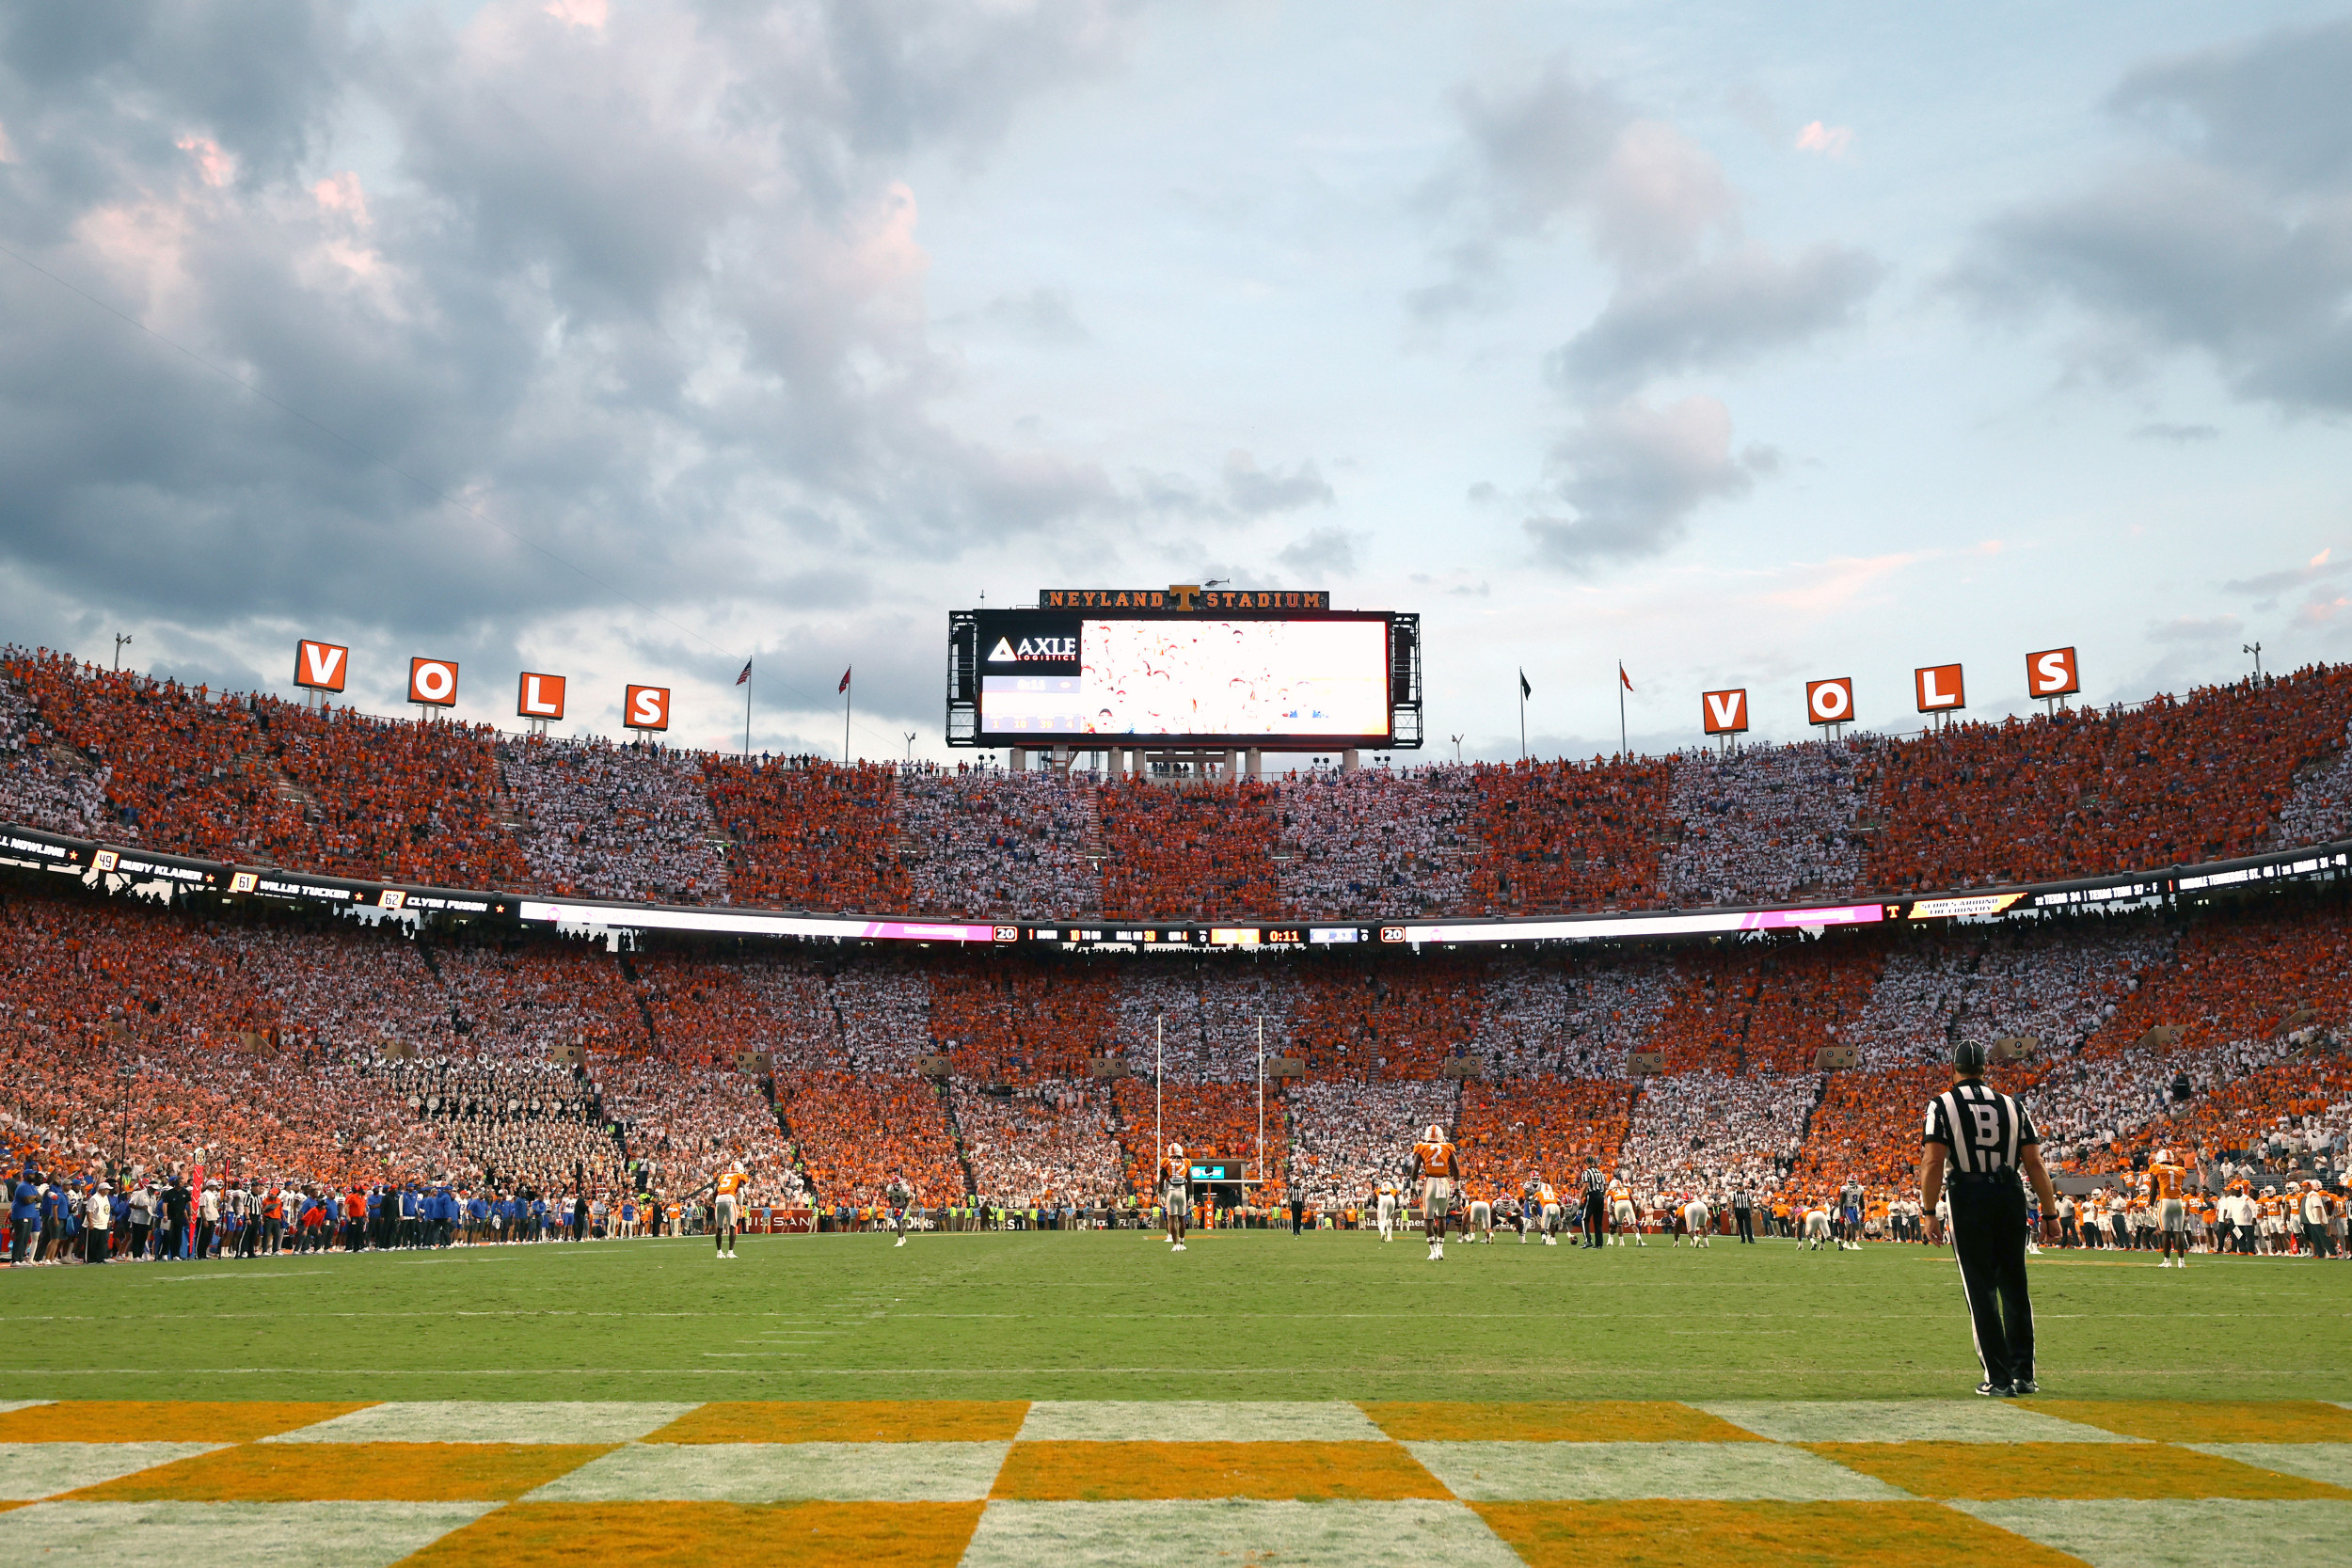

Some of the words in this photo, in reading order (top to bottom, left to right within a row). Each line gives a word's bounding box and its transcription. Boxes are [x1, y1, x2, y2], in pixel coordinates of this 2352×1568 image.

[1050, 592, 1163, 608] NEYLAND
[1207, 592, 1320, 608] STADIUM
[1169, 585, 1200, 611] T
[1017, 638, 1076, 656] AXLE
[306, 643, 342, 685] V
[2039, 654, 2068, 690] S
[416, 663, 453, 700] O
[1017, 679, 1046, 690] 0:11
[1924, 671, 1956, 705] L
[527, 676, 557, 713] L
[1813, 683, 1848, 719] O
[634, 689, 660, 724] S
[1708, 693, 1740, 728] V
[1015, 720, 1027, 729] 10
[1039, 721, 1054, 729] 39
[1066, 720, 1074, 729] 4
[11, 838, 66, 858] NOWLING
[99, 855, 112, 868] 49
[119, 860, 152, 873] RUDY
[154, 865, 203, 881] KLARER
[238, 877, 250, 889] 61
[260, 879, 300, 895] WILLIS
[301, 885, 350, 899] TUCKER
[2089, 889, 2112, 900] TEXAS
[385, 894, 399, 905] 62
[406, 896, 444, 909] CLYDE
[446, 899, 488, 912] FUSON
[1959, 898, 1998, 907] AROUND
[2043, 894, 2067, 905] TEXAS
[2070, 891, 2081, 902] 34
[1887, 906, 1899, 918] T
[1947, 905, 1993, 914] COUNTRY
[997, 928, 1014, 939] 20
[1029, 929, 1033, 940] 1
[1070, 930, 1080, 941] 10
[1144, 931, 1156, 941] 39
[1182, 931, 1187, 940] 4
[1270, 931, 1299, 942] 0:11
[1385, 930, 1402, 940] 20
[1968, 1104, 2000, 1147] B
[1430, 1145, 1444, 1166] 2
[1170, 1162, 1185, 1176] 12
[721, 1174, 734, 1187] 5
[2168, 1170, 2175, 1190] 1
[1852, 1194, 1858, 1203] 9
[2289, 1199, 2299, 1209] 19
[2265, 1202, 2277, 1212] 23
